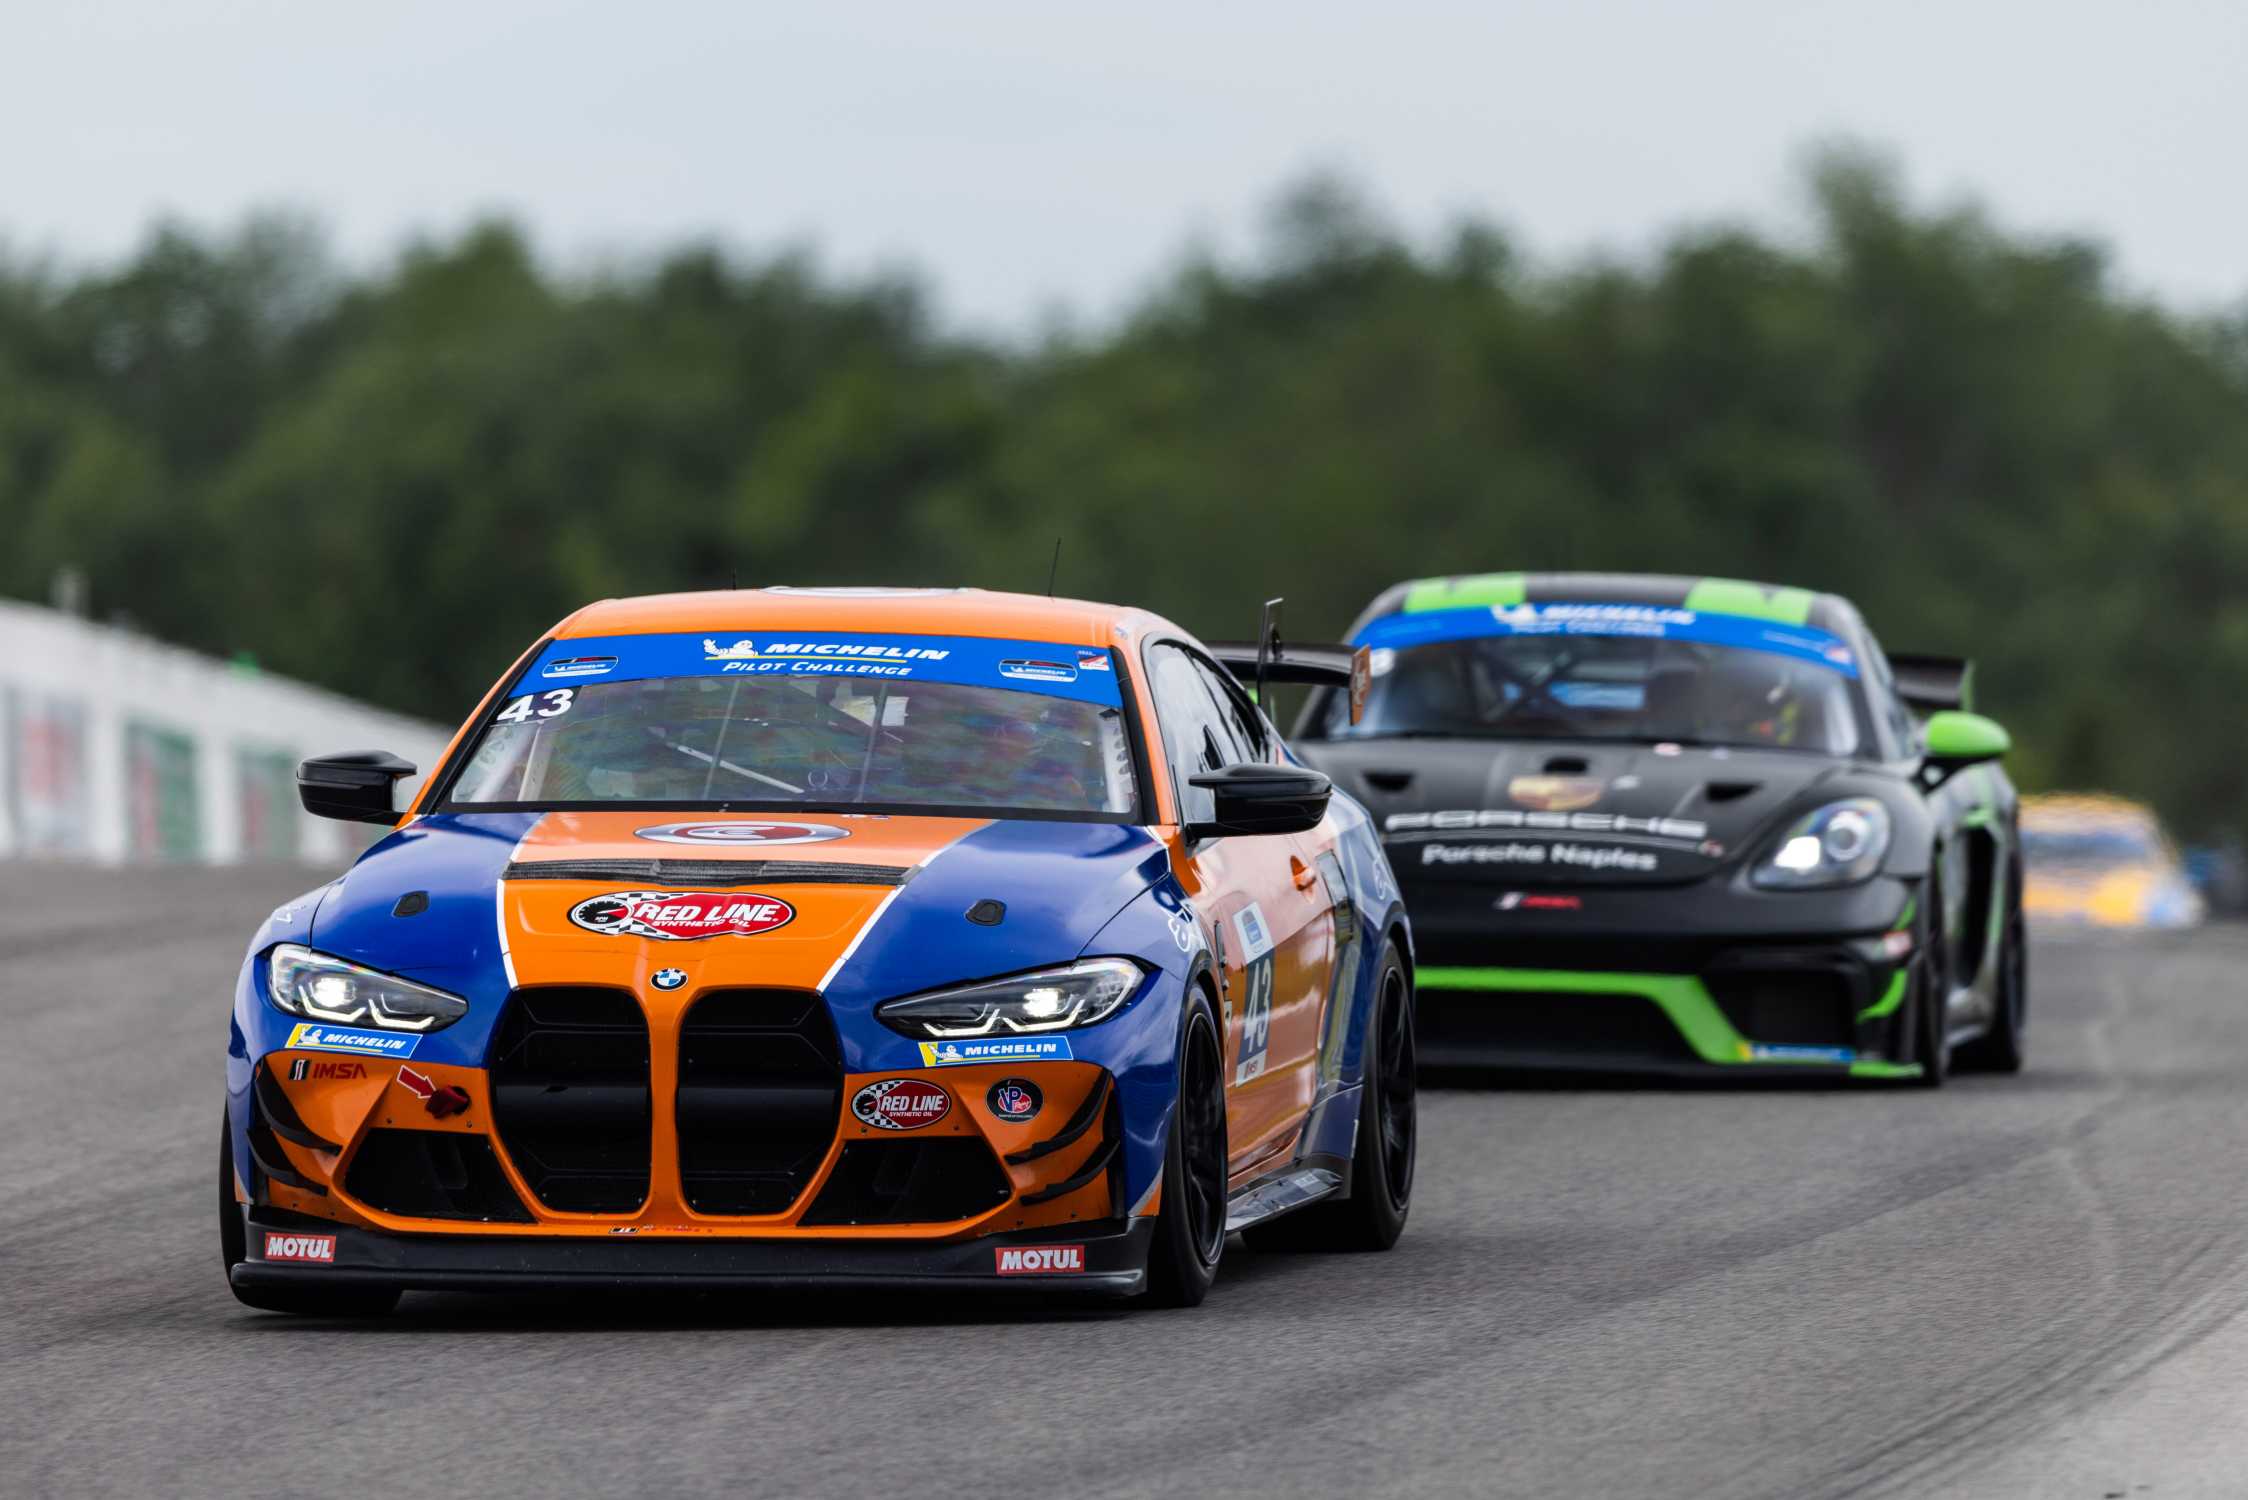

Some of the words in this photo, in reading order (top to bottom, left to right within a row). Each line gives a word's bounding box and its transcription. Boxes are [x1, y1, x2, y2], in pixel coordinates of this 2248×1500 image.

[764, 643, 950, 660] MICHELIN
[722, 661, 787, 672] PILOT
[791, 661, 913, 675] CHALLENGE
[496, 688, 574, 722] 43
[1385, 811, 1708, 839] PORSCHE
[1422, 844, 1546, 866] Porsche
[1551, 846, 1658, 870] Naples
[634, 903, 702, 921] RED
[704, 904, 781, 921] LINE
[651, 917, 725, 927] SYNTHETIC
[729, 919, 751, 928] OIL
[1243, 957, 1273, 1054] 43
[323, 1033, 407, 1049] MICHELIN
[964, 1043, 1057, 1056] MICHELIN
[312, 1062, 368, 1080] IMSA
[880, 1095, 910, 1111] RED
[911, 1095, 945, 1111] LINE
[267, 1236, 331, 1259] MOTUL
[1000, 1248, 1081, 1271] MOTUL
